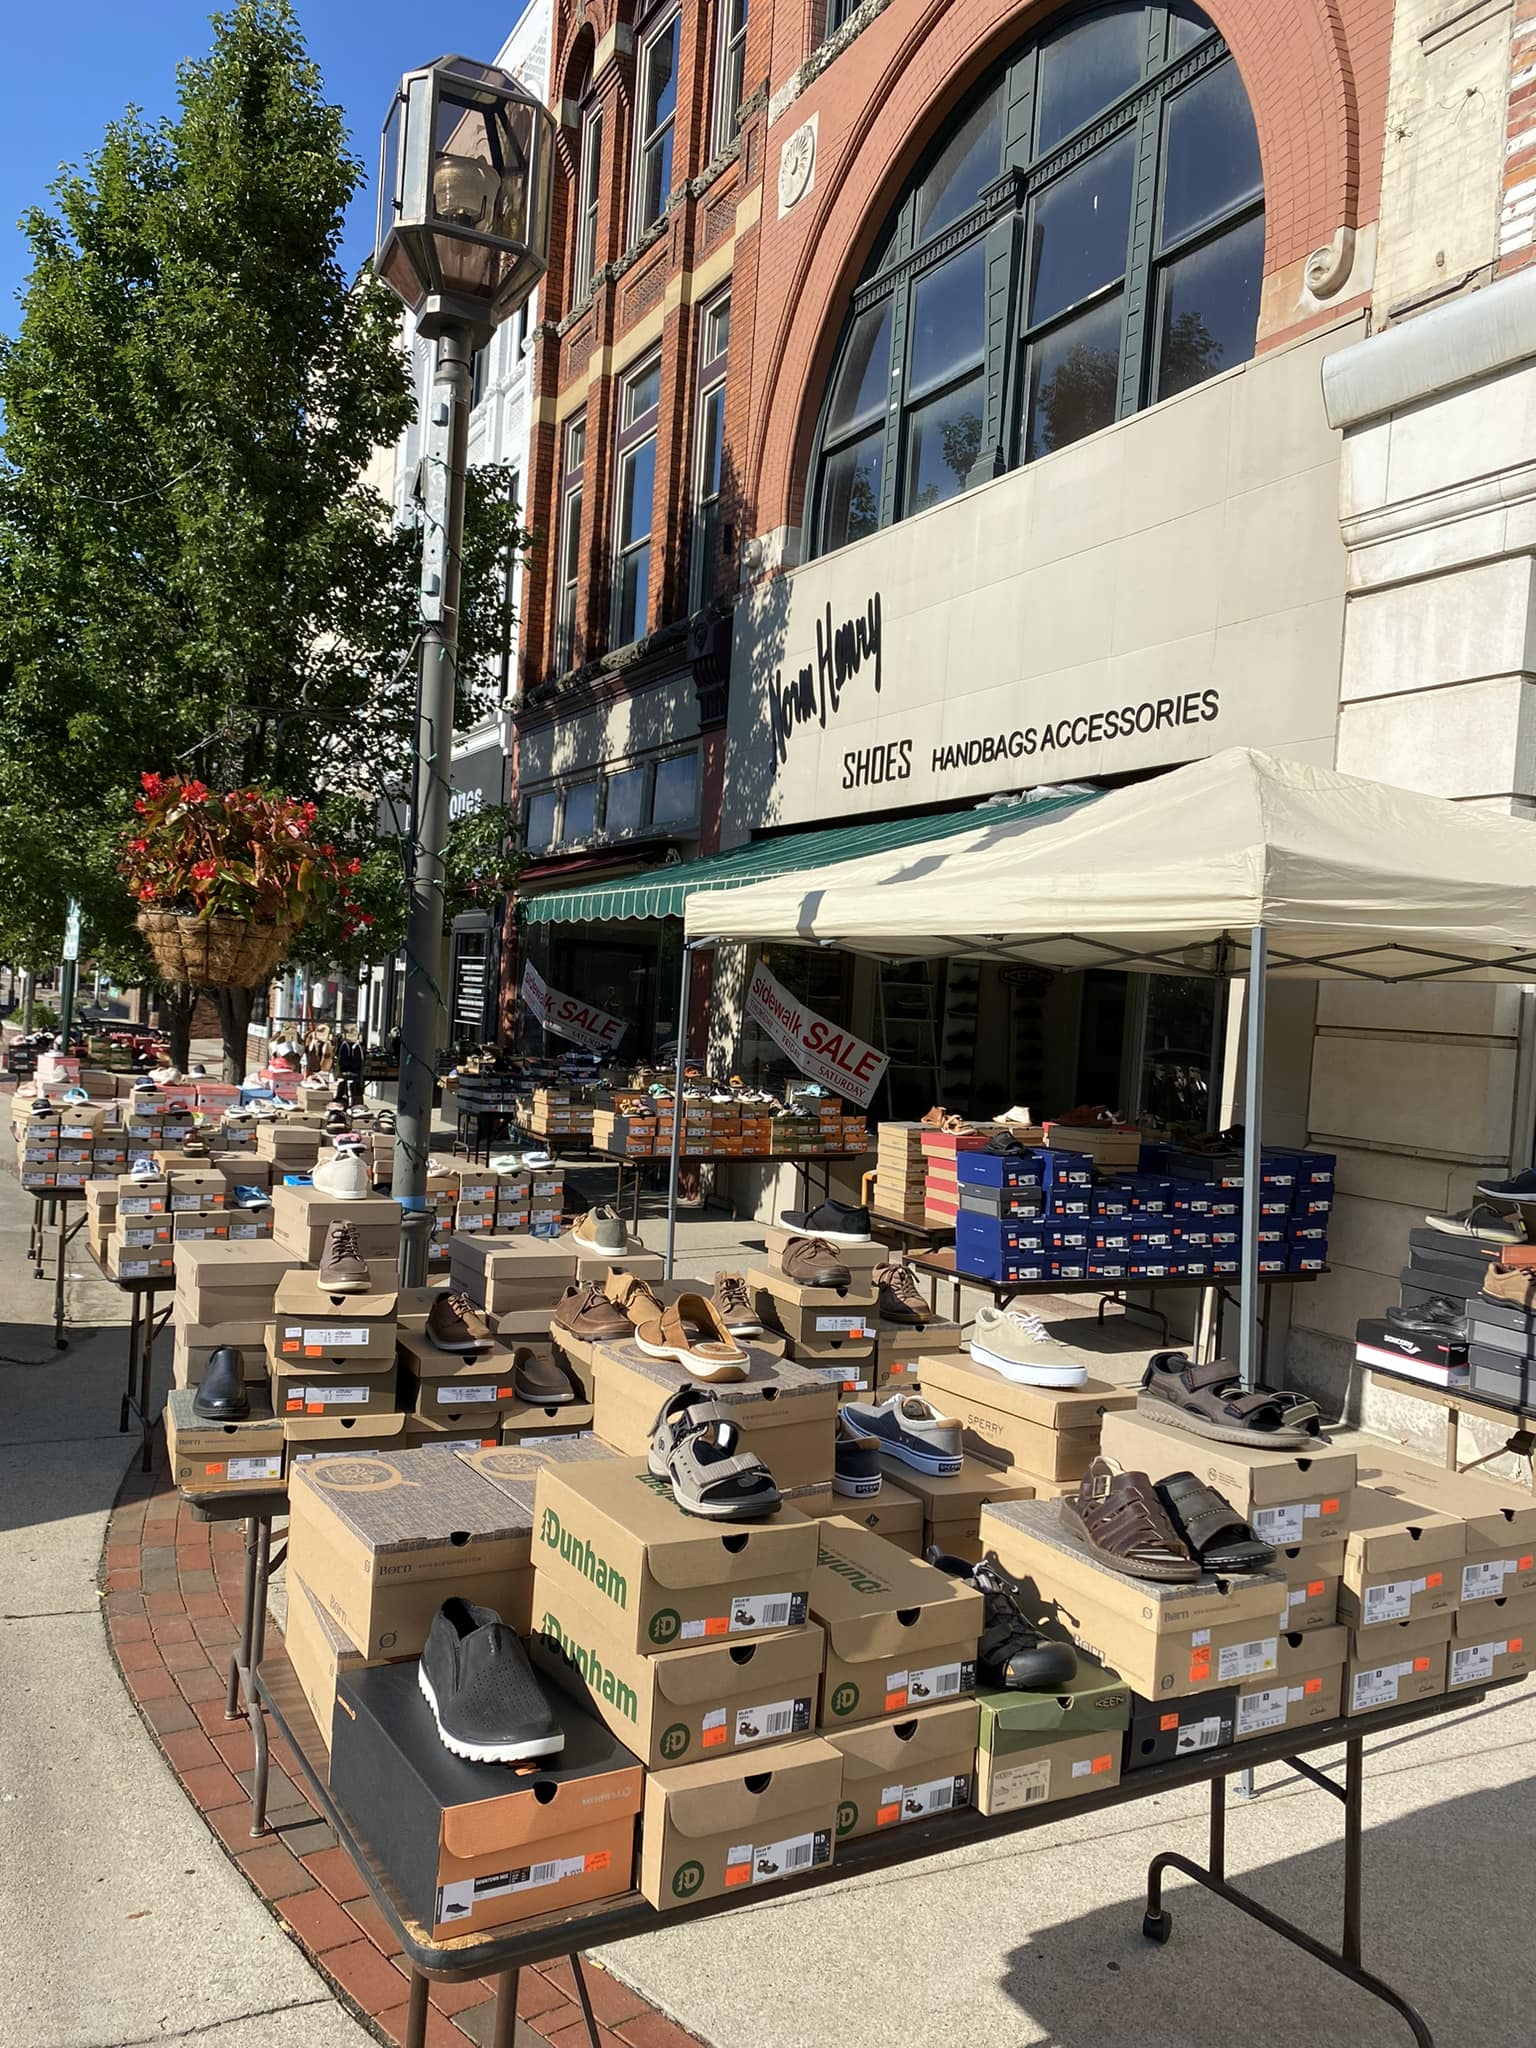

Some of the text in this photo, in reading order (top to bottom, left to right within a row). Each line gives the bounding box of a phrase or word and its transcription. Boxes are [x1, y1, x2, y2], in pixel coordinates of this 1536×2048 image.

[768, 592, 882, 775] Norm Henry
[842, 739, 913, 790] SHOES
[931, 689, 1220, 773] HANDBAGS ACCESSORIES
[557, 1001, 622, 1041] SALE
[752, 977, 883, 1083] sidewalk SALE
[781, 1035, 801, 1058] FRIDAY
[817, 1066, 866, 1098] SATURDAY
[967, 1414, 1004, 1433] SPERRY
[540, 1506, 628, 1611] Dunham
